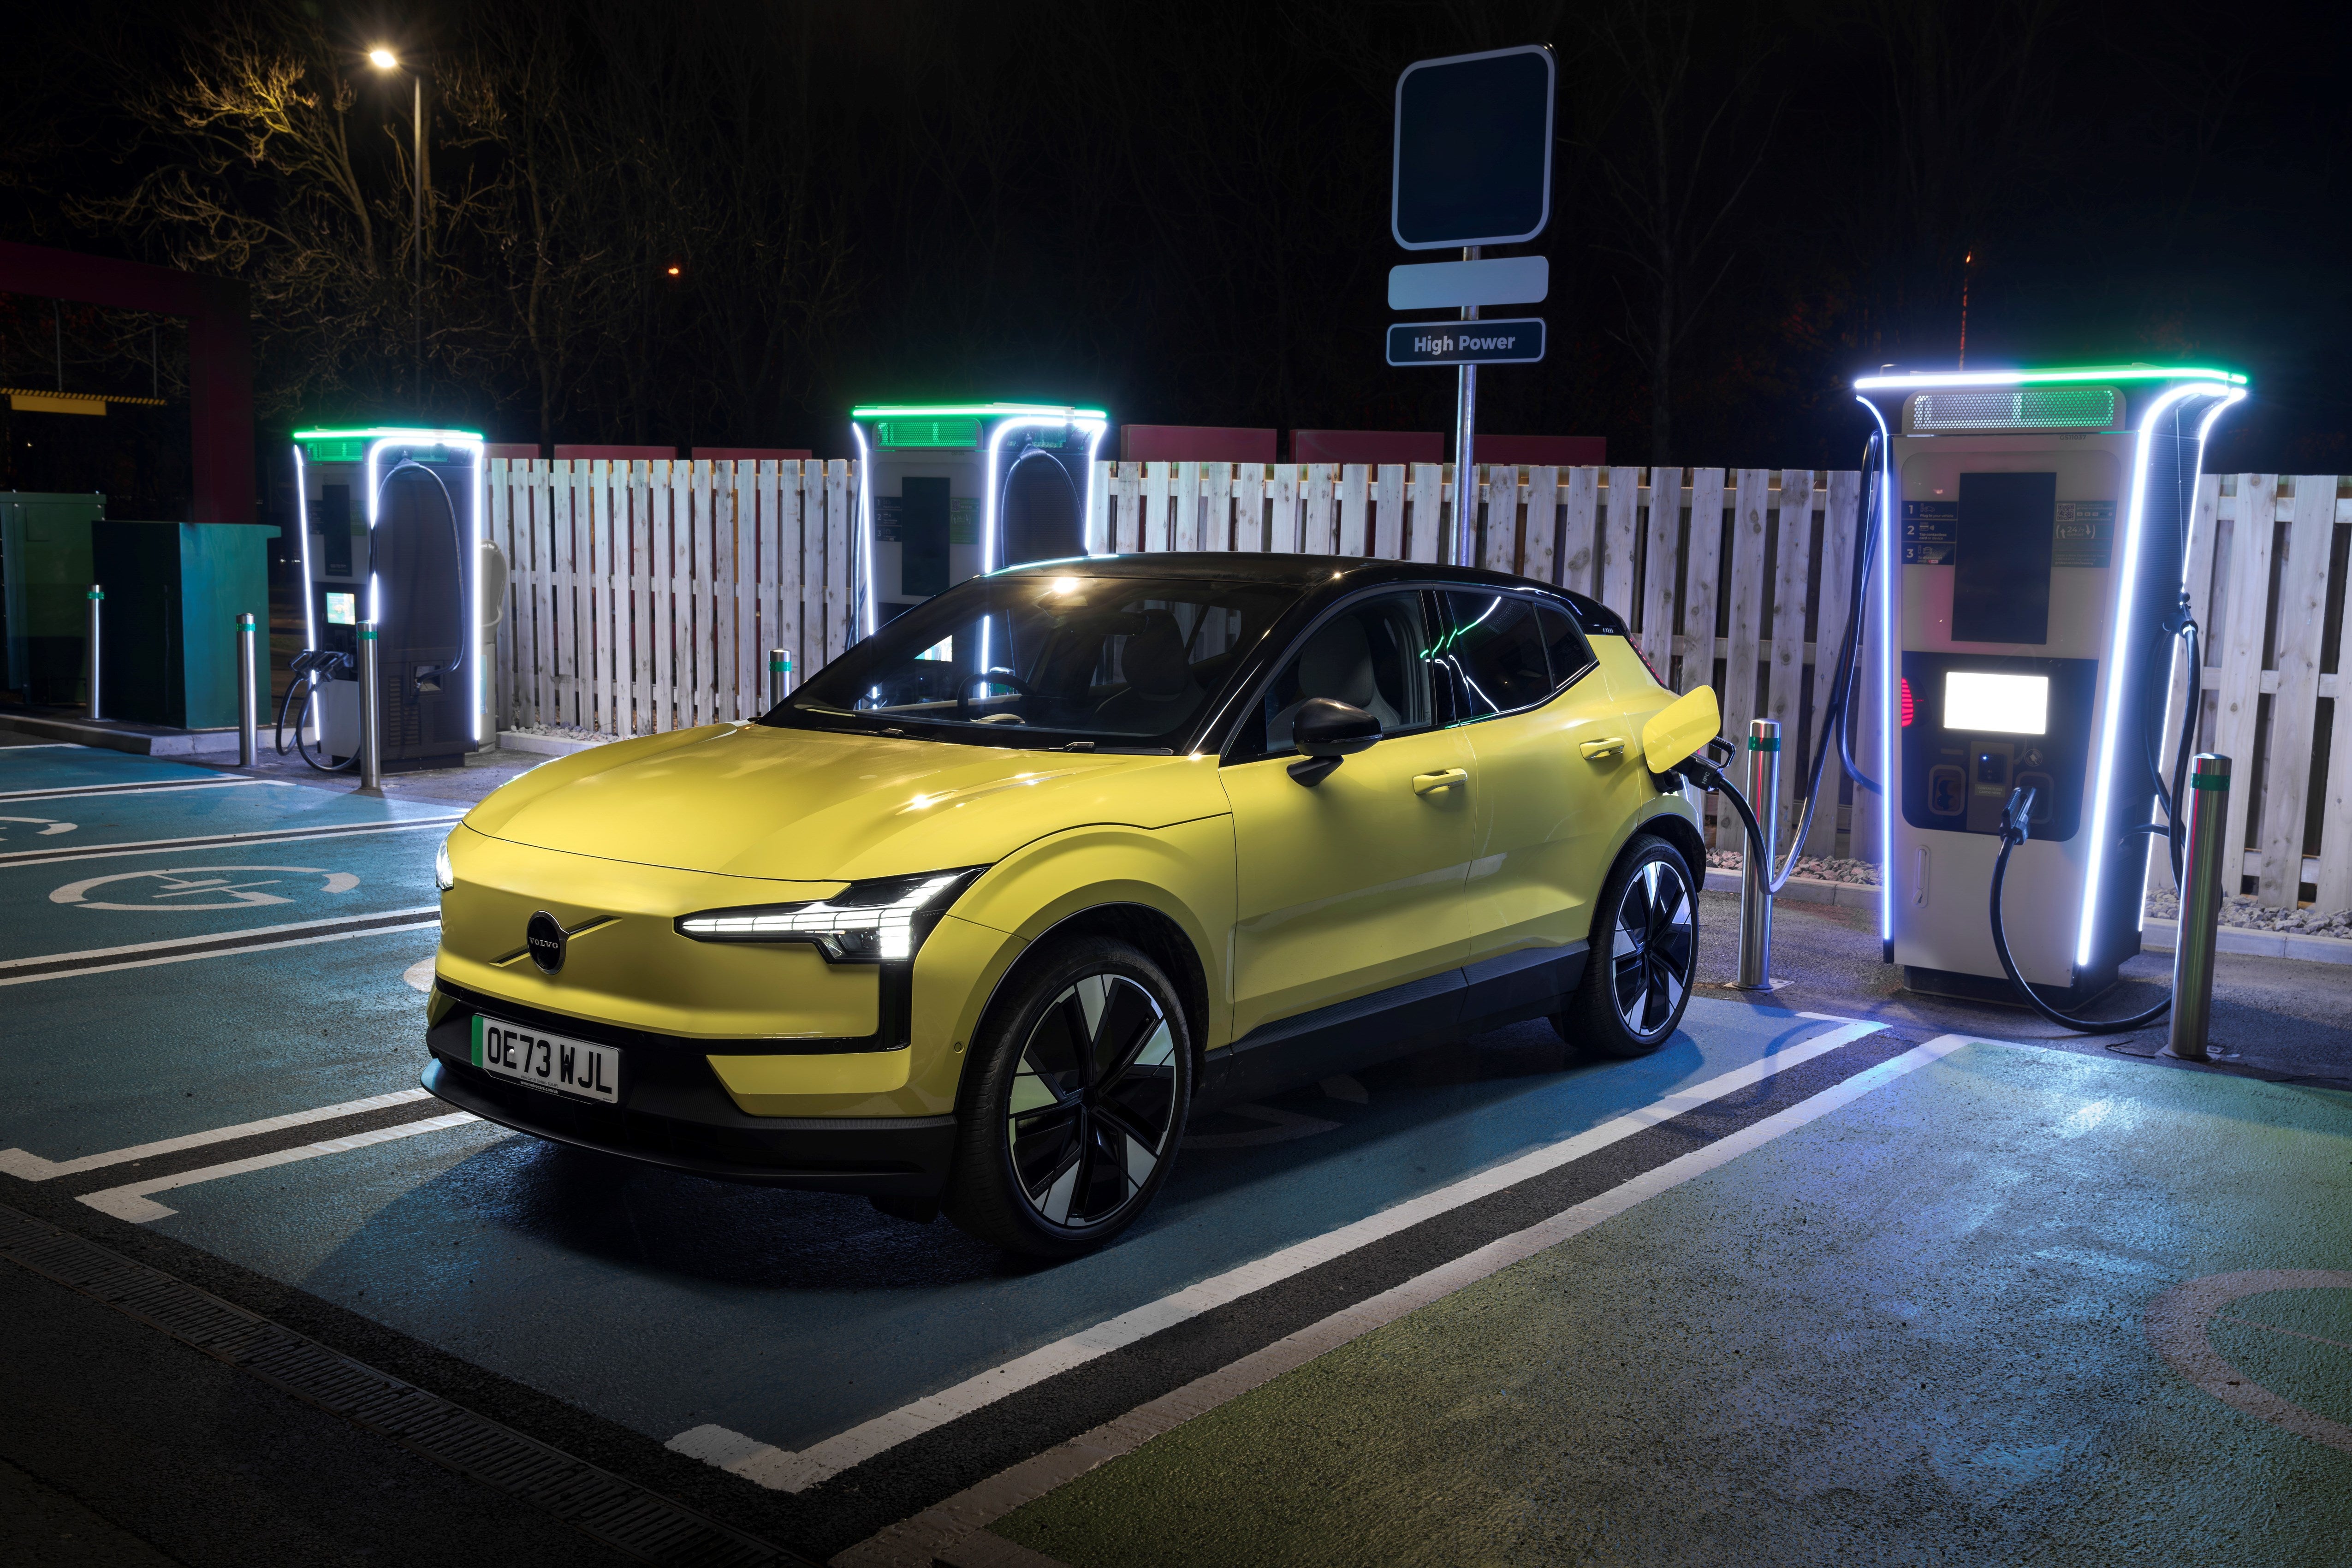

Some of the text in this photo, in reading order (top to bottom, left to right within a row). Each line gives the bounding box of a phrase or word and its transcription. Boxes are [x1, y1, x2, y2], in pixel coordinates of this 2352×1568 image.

[1414, 336, 1515, 355] High Power
[1908, 505, 1913, 514] 1
[1907, 525, 1915, 535] 2
[1906, 549, 1914, 558] 3
[1701, 772, 1710, 784] HPC
[529, 937, 558, 949] VOLVO
[487, 1027, 612, 1095] OE73 WJL
[520, 1081, 558, 1094] www.volvocars.com/uk
